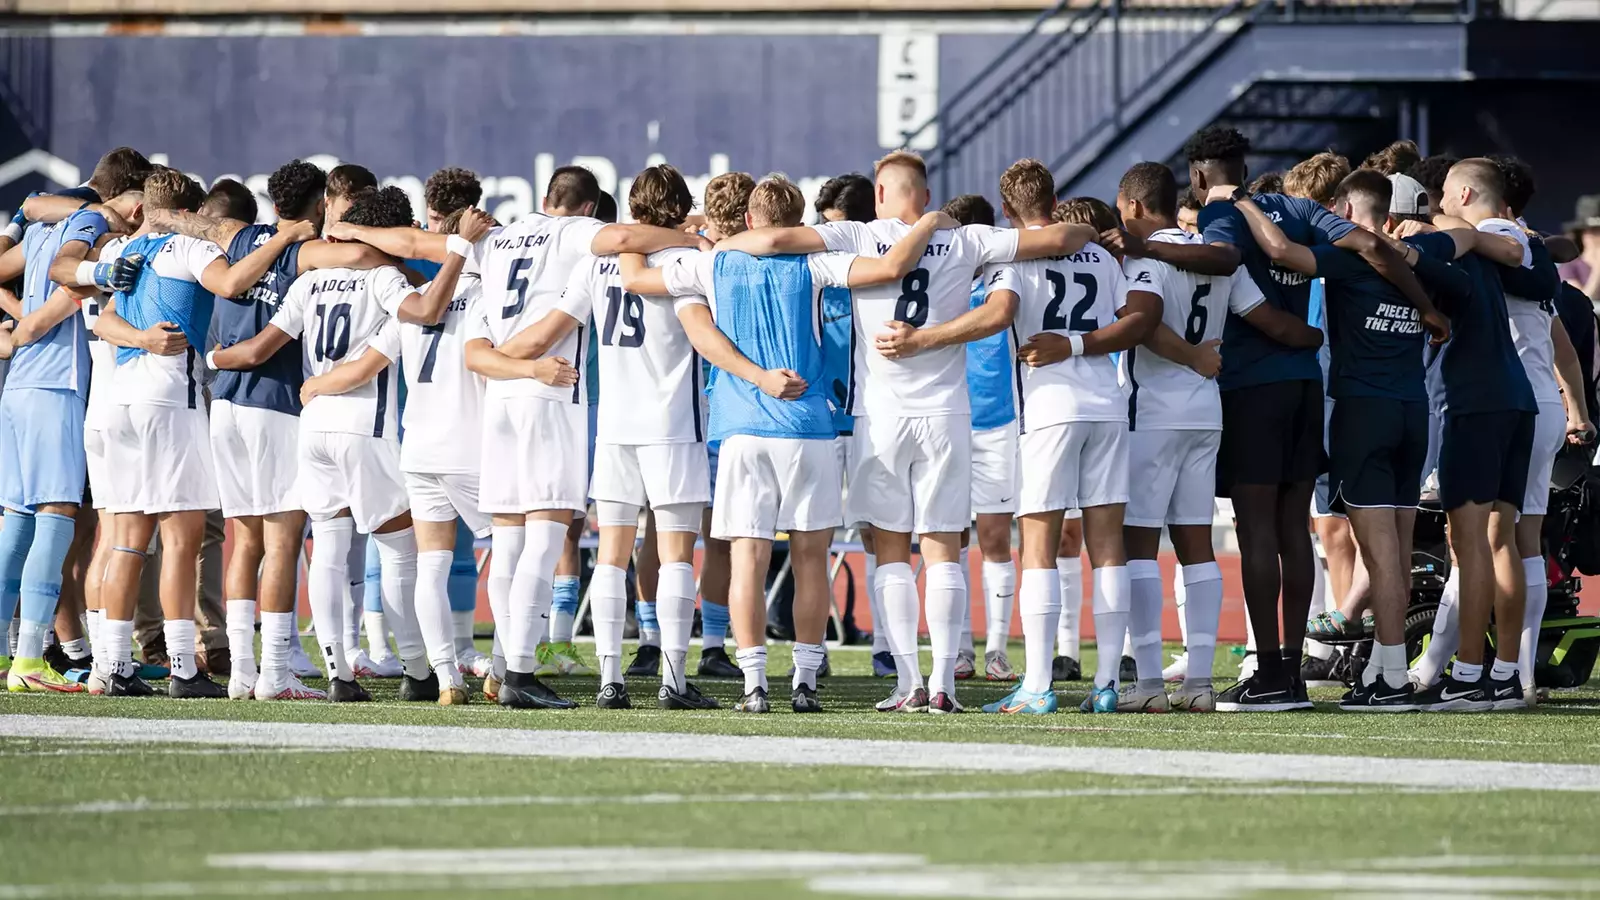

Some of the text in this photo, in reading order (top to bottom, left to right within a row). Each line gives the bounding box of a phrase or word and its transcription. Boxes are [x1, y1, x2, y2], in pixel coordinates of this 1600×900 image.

[501, 257, 534, 319] 5
[602, 286, 646, 348] 19
[894, 267, 930, 328] 8
[1042, 268, 1099, 331] 22
[1185, 283, 1212, 346] 6
[1375, 302, 1410, 320] PIECE
[315, 302, 352, 362] 10
[417, 323, 446, 383] 7
[1364, 316, 1391, 332] THE
